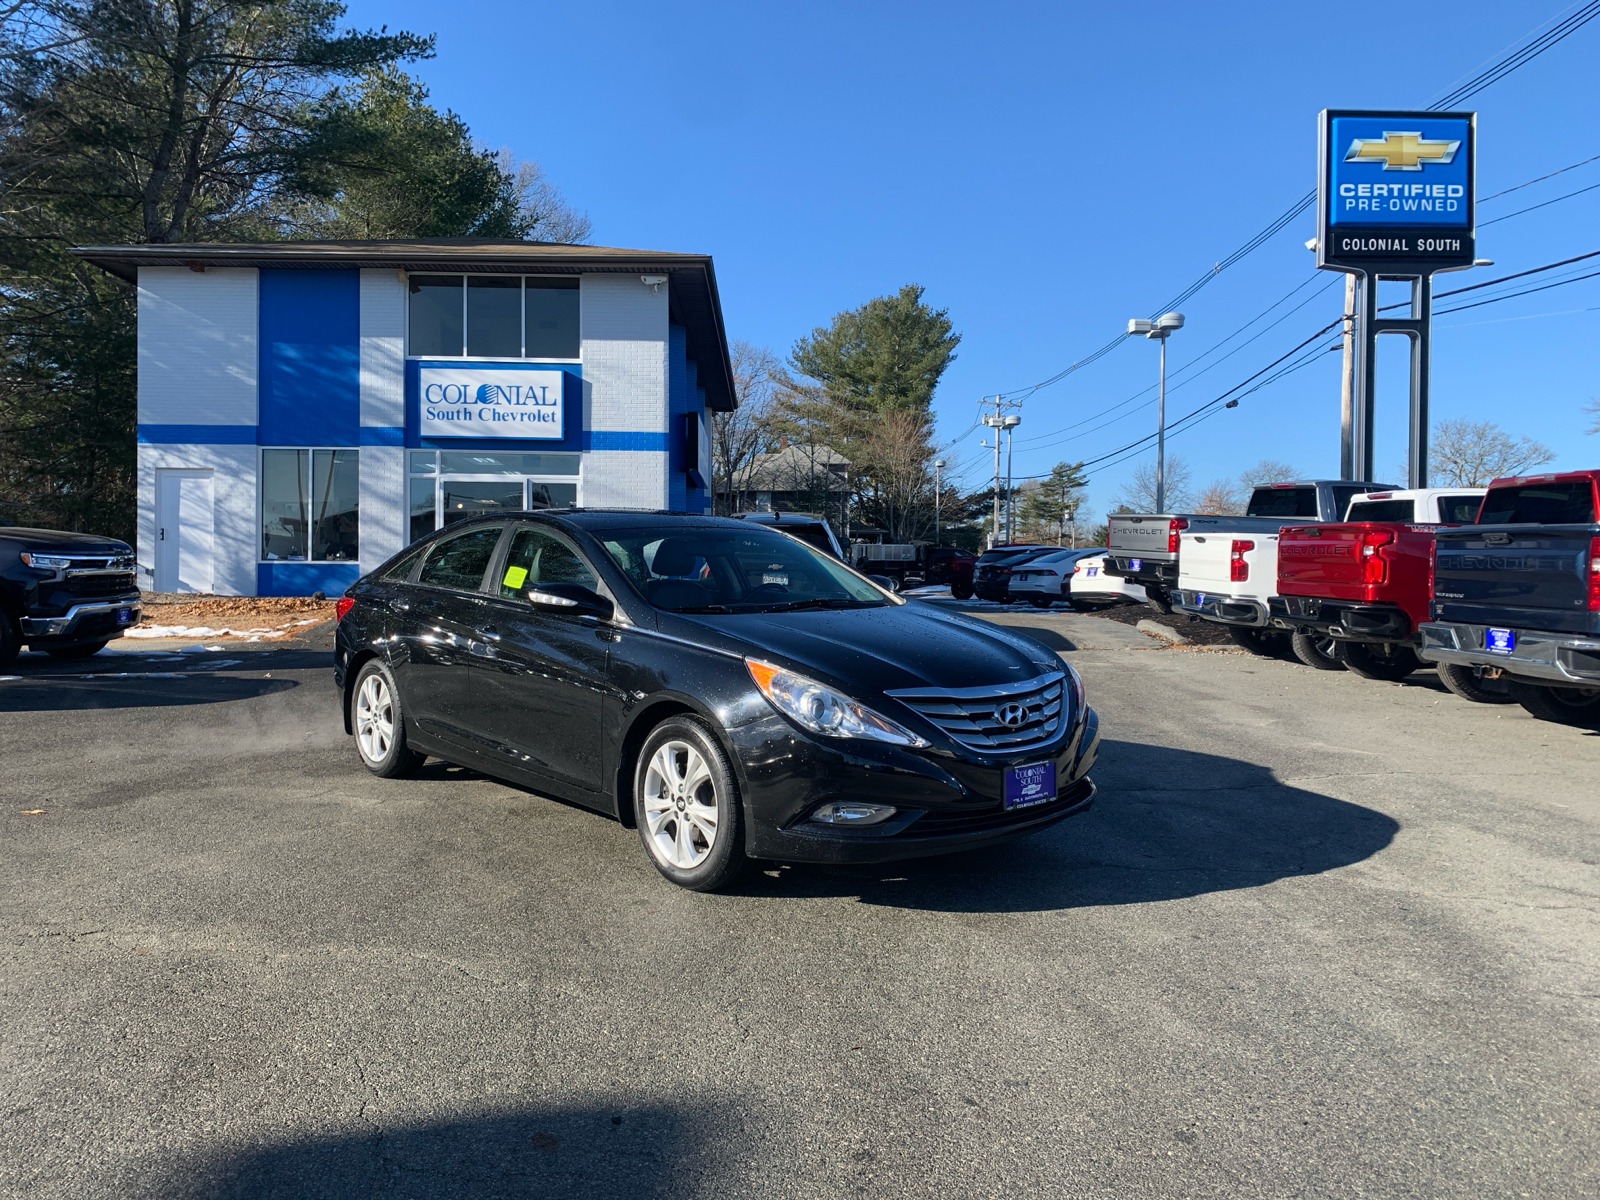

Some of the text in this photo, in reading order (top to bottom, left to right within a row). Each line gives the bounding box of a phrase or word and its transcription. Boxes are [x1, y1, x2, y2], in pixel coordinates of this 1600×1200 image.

[1339, 183, 1464, 198] CERTIFIED
[1345, 198, 1458, 212] PRE-OWNED
[1342, 238, 1460, 251] COLONIAL SOUTH
[425, 383, 557, 406] COLONIAL
[426, 406, 557, 423] South Chevrolet
[1281, 546, 1352, 555] CHEVROLET
[1438, 556, 1571, 571] CHEVROLET
[1015, 766, 1047, 780] COLONIAL
[1020, 775, 1042, 786] SOUTH
